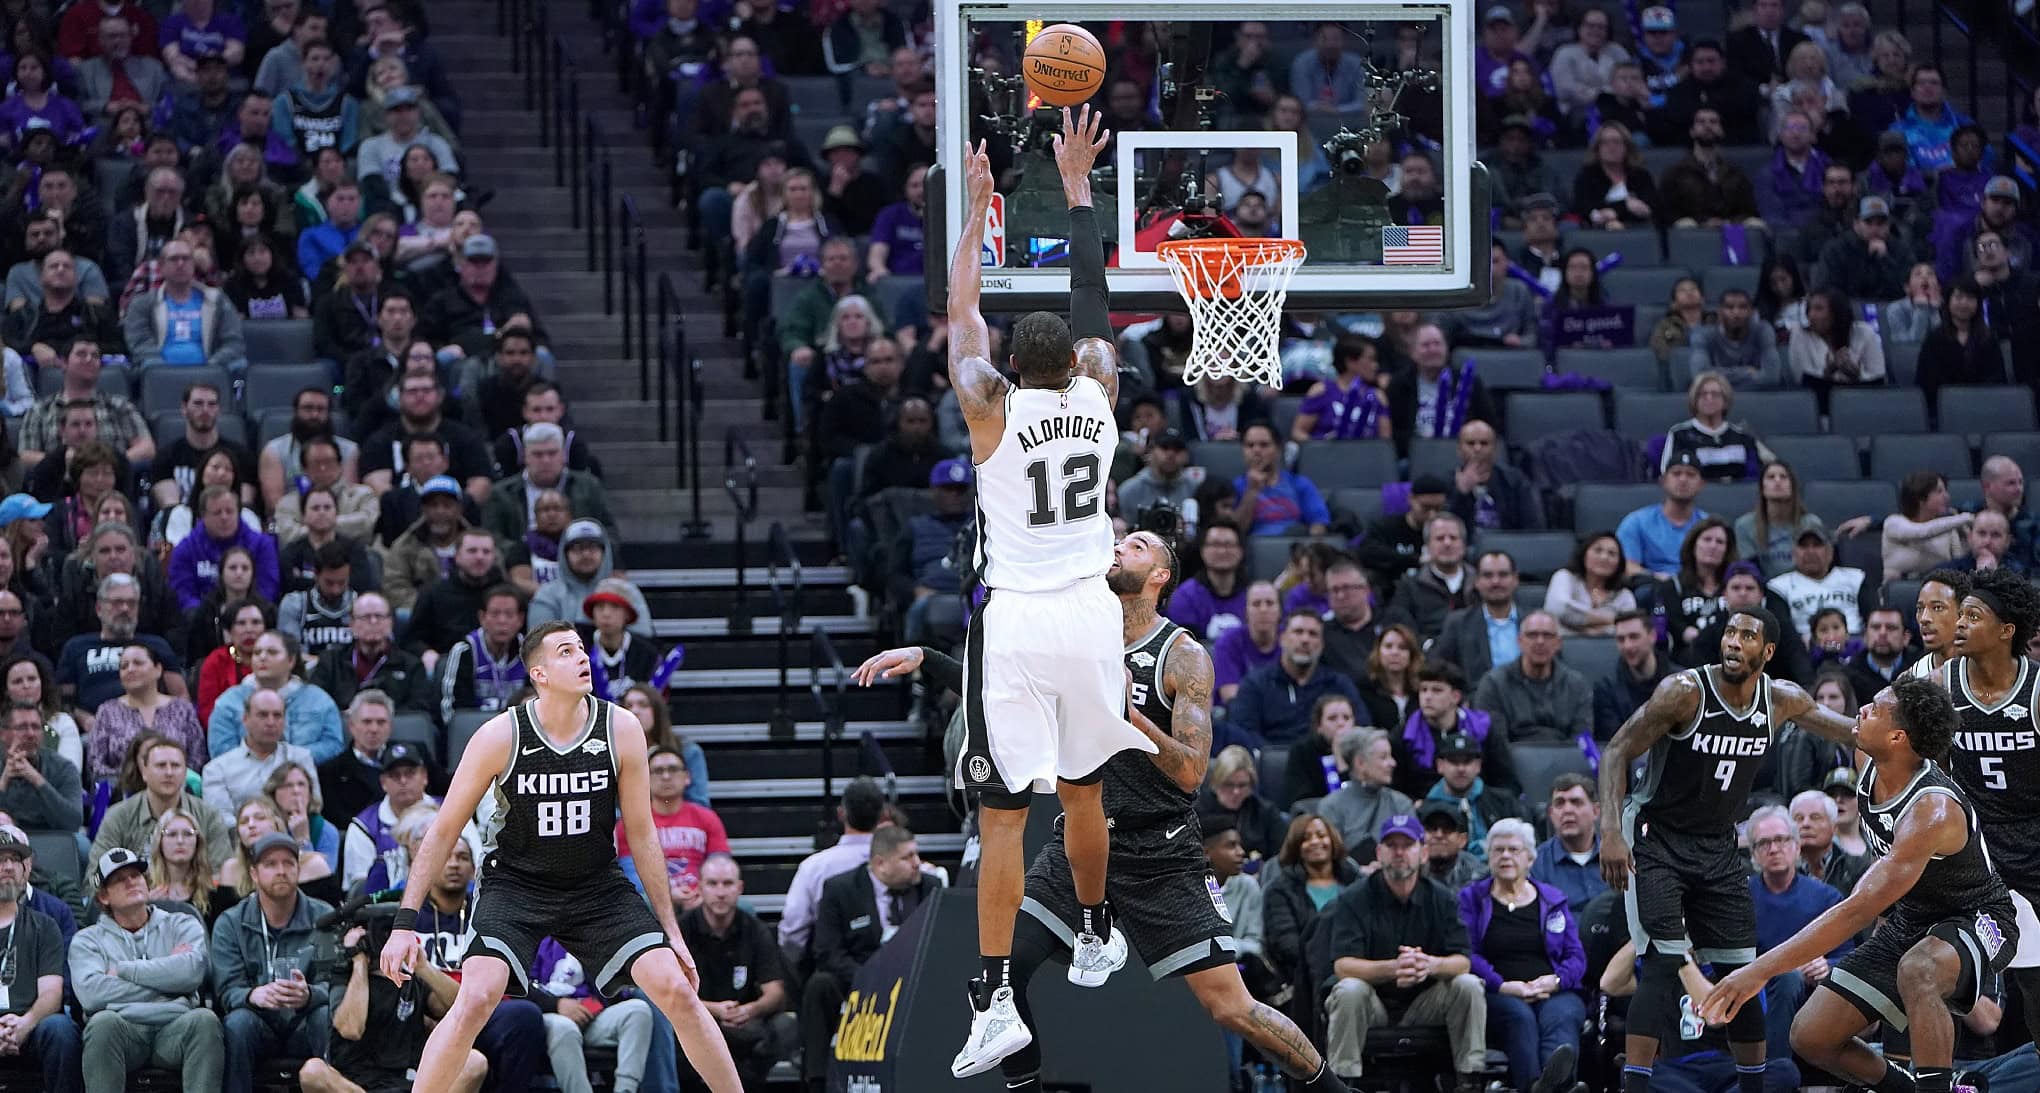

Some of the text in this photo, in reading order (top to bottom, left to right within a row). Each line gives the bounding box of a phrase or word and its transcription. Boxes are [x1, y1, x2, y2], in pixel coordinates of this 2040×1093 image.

[1033, 59, 1090, 82] SPALDING
[980, 278, 1013, 290] LDING
[1017, 415, 1105, 453] ALDRIDGE
[1024, 450, 1102, 529] 12
[303, 626, 353, 645] KING
[1691, 732, 1768, 757] KINGS
[1953, 730, 2036, 752] KINGS
[517, 769, 609, 795] KINGS
[1714, 759, 1737, 792] 9
[1980, 756, 2008, 790] 5
[537, 799, 592, 837] 88
